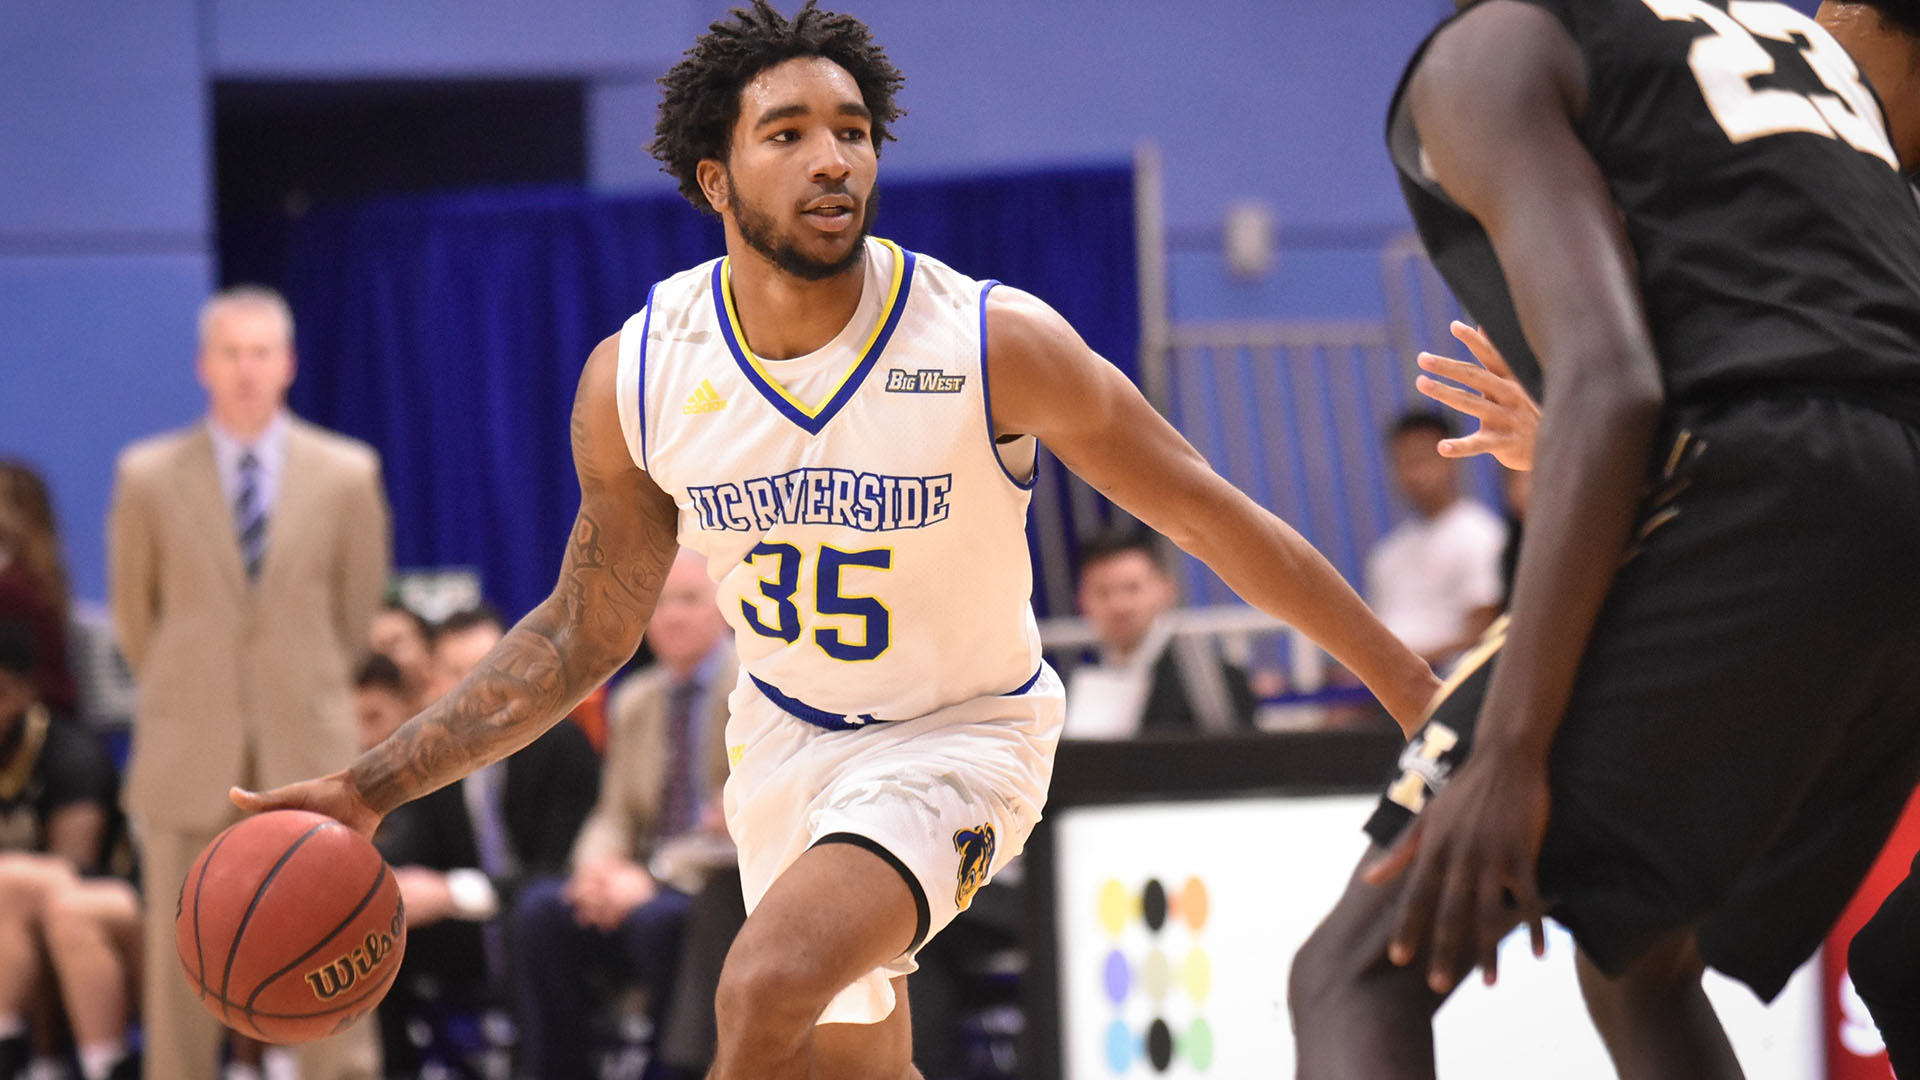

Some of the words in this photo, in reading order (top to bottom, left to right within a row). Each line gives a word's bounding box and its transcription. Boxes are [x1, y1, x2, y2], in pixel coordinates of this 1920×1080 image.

[1642, 0, 1900, 172] 23
[682, 400, 728, 415] adidas
[686, 483, 752, 532] UC
[740, 539, 895, 662] 35
